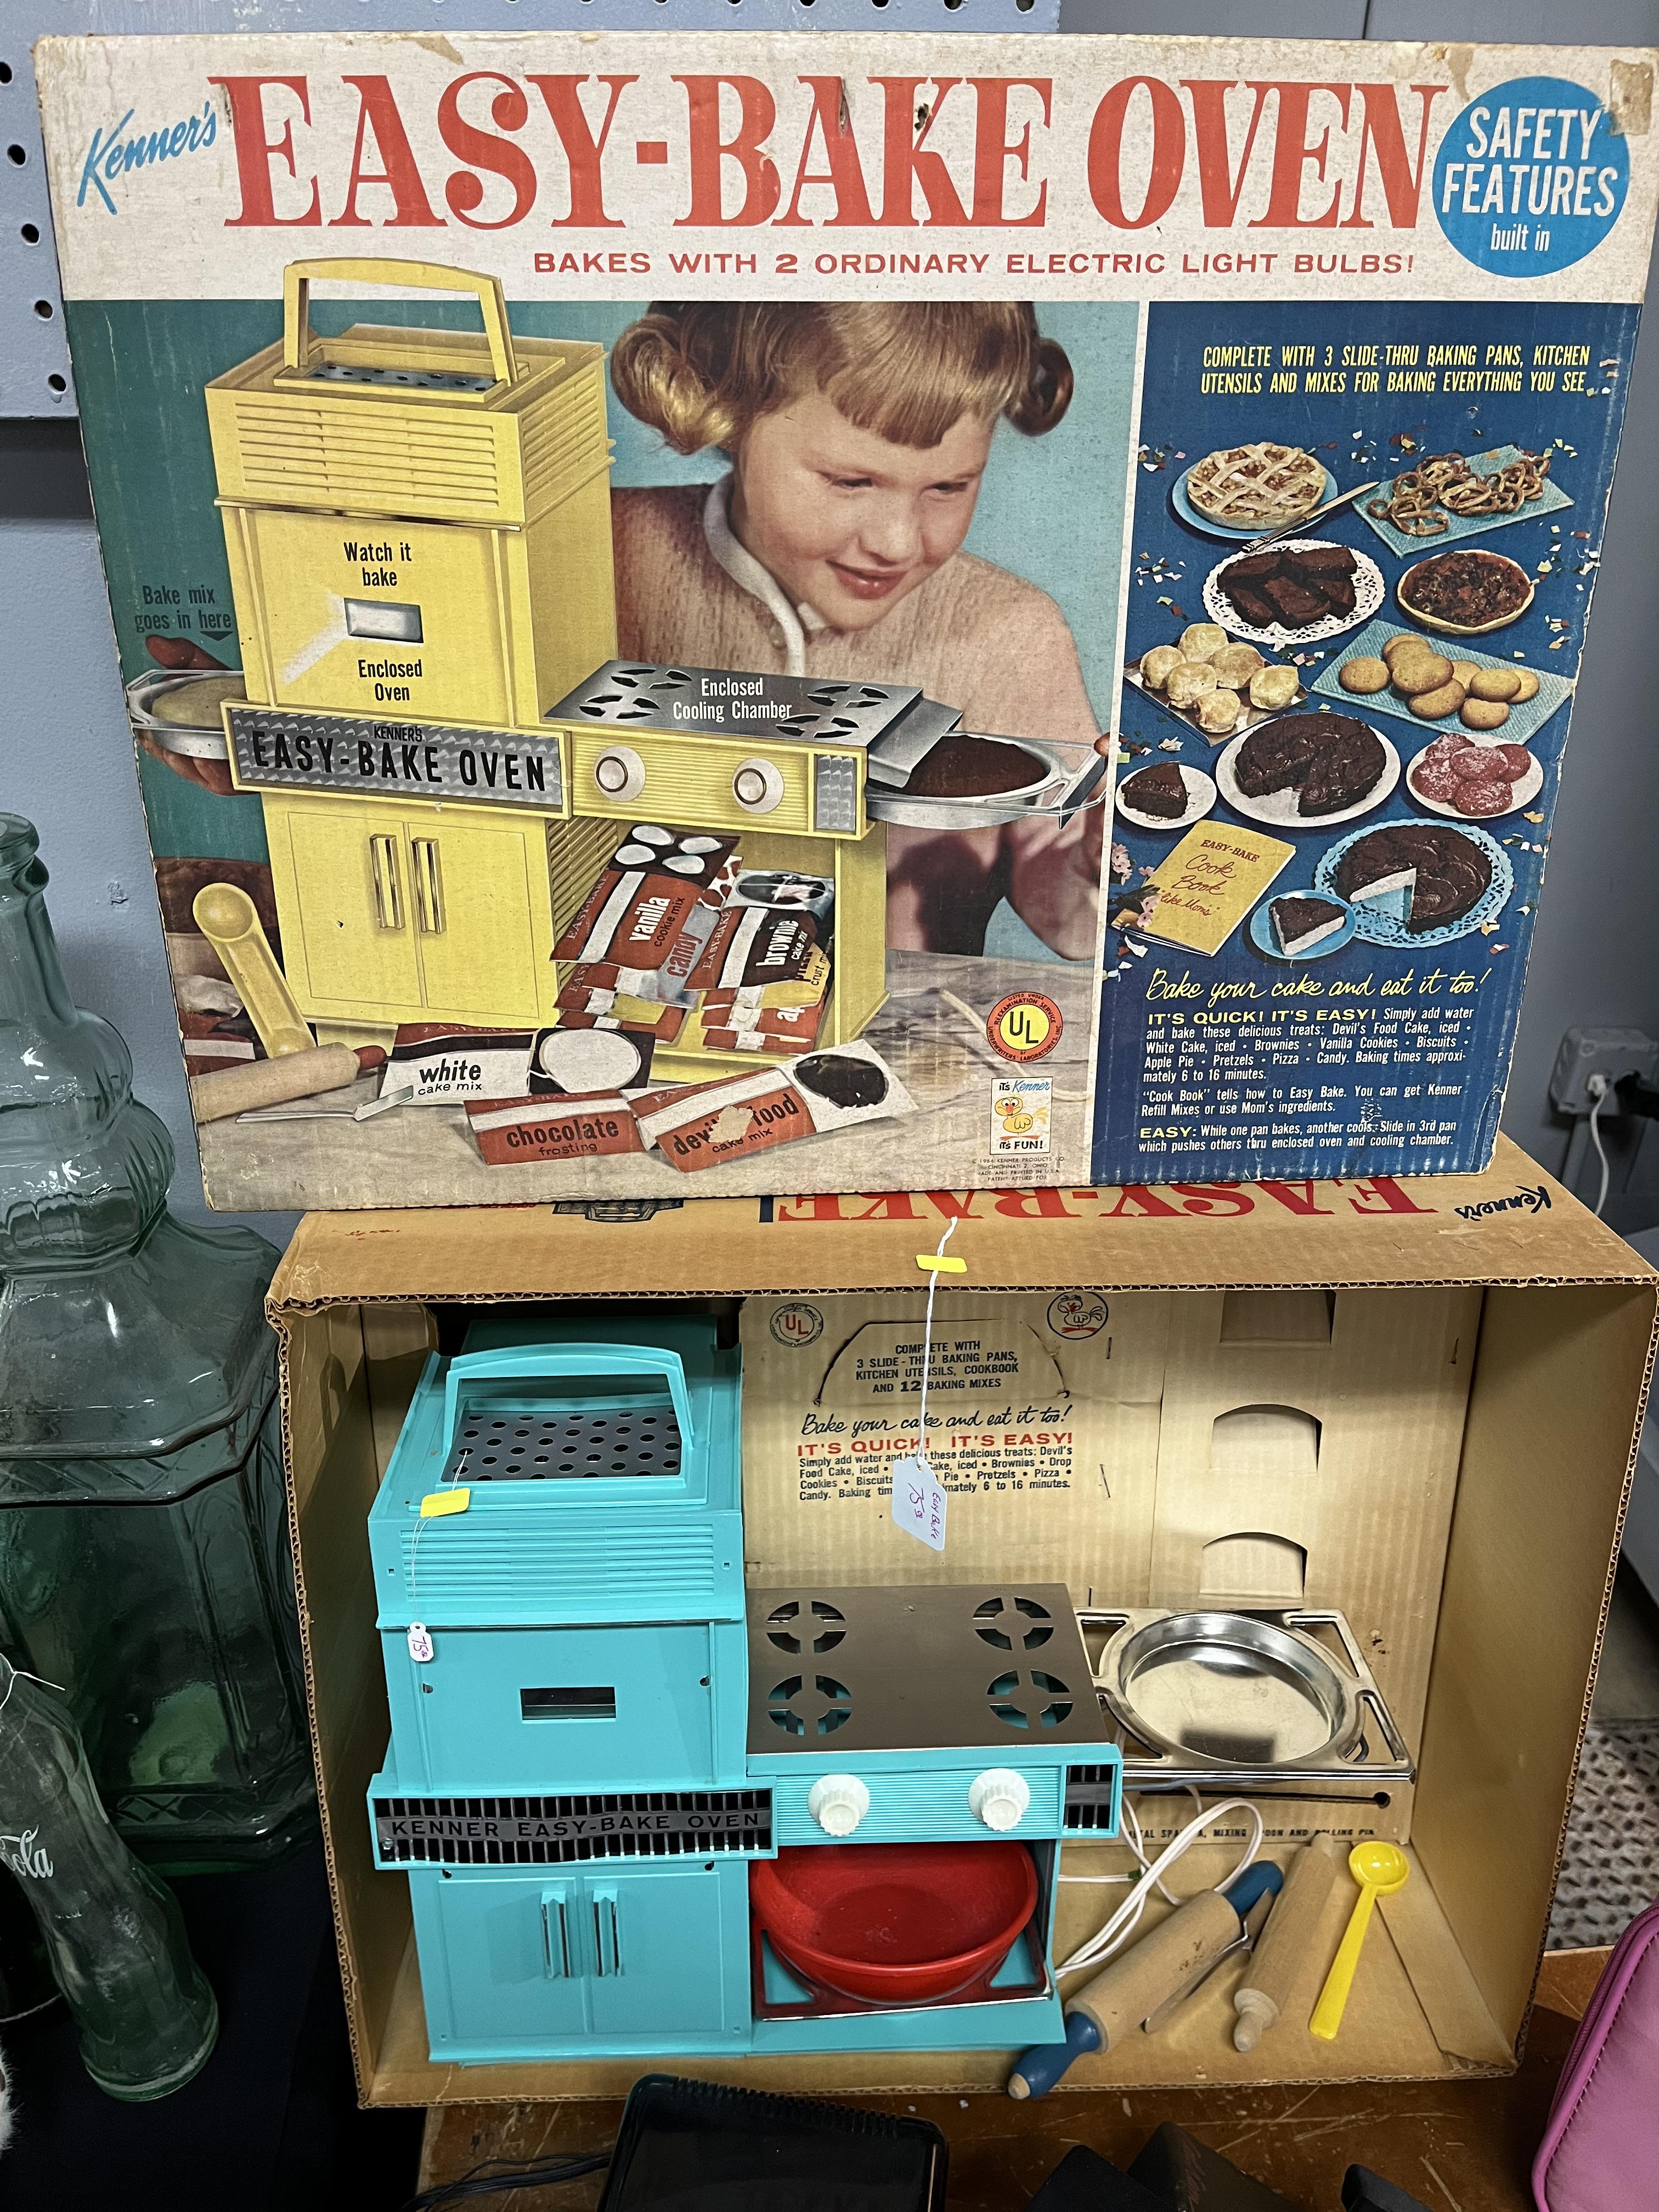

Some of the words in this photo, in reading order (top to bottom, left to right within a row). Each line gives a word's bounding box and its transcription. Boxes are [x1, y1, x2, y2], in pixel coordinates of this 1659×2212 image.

[1466, 106, 1604, 160] SAFETY
[77, 101, 216, 215] Kenner's
[207, 71, 1052, 229] EASY-BAKE
[1087, 75, 1449, 229] OVEN
[1441, 163, 1618, 217] FEATURES
[1491, 224, 1528, 251] built
[1534, 224, 1549, 251] in
[534, 253, 651, 273] BAKES
[669, 254, 757, 273] WITH
[775, 254, 798, 273] 2
[815, 254, 989, 274] ORDINARY
[1007, 253, 1165, 274] ELECTRIC
[1183, 253, 1278, 273] LIGHT
[1294, 254, 1414, 273] BULBS!
[1203, 345, 1272, 367] COMPLETE
[1282, 345, 1314, 367] WITH
[1324, 346, 1332, 367] 3
[1341, 345, 1418, 368] SLIDE-THRU
[1427, 345, 1476, 367] BAKING
[1486, 345, 1523, 369] PANS,
[1533, 345, 1590, 366] KITCHEN
[1201, 373, 1262, 394] UTENSILS
[1269, 372, 1297, 393] AND
[1305, 372, 1345, 393] MIXES
[1355, 371, 1379, 393] FOR
[1387, 371, 1435, 393] BAKING
[1443, 370, 1521, 393] EVERYTHING
[1530, 371, 1556, 392] YOU
[344, 541, 394, 563] Watch
[400, 542, 412, 562] it
[362, 567, 398, 587] bake
[143, 585, 181, 605] Bake
[189, 586, 216, 605] mix
[134, 612, 170, 633] goes
[177, 610, 191, 630] in
[199, 608, 232, 629] here
[358, 658, 423, 679] Enclosed
[374, 682, 410, 702] Oven
[701, 678, 763, 696] Enclosed
[673, 701, 724, 723] Cooling
[732, 701, 792, 719] Chamber
[374, 725, 422, 742] KENNER'S
[252, 731, 444, 783] EASY-BAKE
[459, 749, 546, 791] OVEN
[1200, 839, 1260, 862] EASY-BAKE
[1186, 854, 1237, 878] Cook
[1171, 875, 1227, 895] Book
[629, 896, 671, 941] vanilla
[654, 916, 675, 946] cookie
[672, 897, 685, 915] mix
[703, 911, 732, 968] EASY-BAKE
[755, 920, 799, 966] brownie
[791, 943, 804, 960] cake
[811, 966, 825, 985] crust
[1146, 967, 1204, 1001] Bake
[1207, 979, 1268, 1008] your
[1270, 974, 1325, 997] cake
[1328, 973, 1376, 997] and
[1380, 969, 1415, 996] eat
[1419, 968, 1449, 995] it
[1448, 967, 1492, 995] too!
[1148, 1013, 1184, 1025] IT'S
[1193, 1011, 1265, 1024] QUICK!
[1271, 1010, 1307, 1022] IT'S
[1316, 1008, 1376, 1021] EASY!
[1383, 1008, 1416, 1021] Simply
[1421, 1007, 1440, 1020] add
[1445, 1008, 1474, 1019] water
[1009, 1011, 1039, 1043] UL
[1146, 1028, 1165, 1040] and
[1172, 1027, 1195, 1039] bake
[1203, 1026, 1230, 1039] these
[1238, 1025, 1282, 1037] delicious
[1290, 1024, 1325, 1036] treats:
[1332, 1022, 1366, 1035] Devil's
[1373, 1023, 1397, 1034] Food
[1404, 1022, 1430, 1035] Cake,
[1439, 1022, 1460, 1034] iced
[1146, 1041, 1175, 1054] White
[1181, 1041, 1208, 1054] Cake,
[1215, 1040, 1235, 1052] iced
[1255, 1039, 1299, 1051] Brownies
[1320, 1037, 1352, 1049] Vanilla
[1360, 1037, 1398, 1049] Cookies
[1417, 1036, 1456, 1048] Biscuits
[1144, 1056, 1171, 1070] Apple
[1178, 1056, 1194, 1068] Pie
[1213, 1054, 1254, 1066] Pretzels
[1272, 1053, 1299, 1065] Pizza
[1317, 1052, 1349, 1066] Candy.
[1355, 1051, 1388, 1065] Baking
[1393, 1051, 1421, 1063] times
[1426, 1050, 1466, 1064] approxi-
[419, 1058, 481, 1084] white
[1143, 1070, 1176, 1085] mately
[1182, 1070, 1188, 1082] 6
[1193, 1069, 1204, 1081] to
[1209, 1069, 1220, 1081] 16
[1224, 1068, 1267, 1081] minutes.
[418, 1083, 451, 1095] cake
[456, 1081, 482, 1090] mix
[1012, 1080, 1050, 1092] Kenner
[506, 1119, 619, 1148] chocolate
[748, 1128, 773, 1142] mix
[1140, 1126, 1197, 1138] EASY:
[1201, 1125, 1227, 1136] While
[1231, 1125, 1248, 1136] one
[1251, 1125, 1268, 1137] pan
[1272, 1123, 1302, 1135] bakes,
[538, 1143, 597, 1156] frosting
[1014, 1141, 1043, 1149] FUN!
[1454, 1185, 1551, 1221] Kenner's
[786, 1314, 809, 1335] UL
[955, 1341, 980, 1351] WITH
[942, 1353, 979, 1364] BAKING
[987, 1351, 1018, 1362] PANS,
[856, 1369, 899, 1380] KITCHEN
[964, 1363, 1019, 1374] COOKBOOK
[900, 1381, 922, 1392] 12
[969, 1378, 1001, 1388] MIXES
[802, 1413, 848, 1435] Bake
[851, 1419, 898, 1438] your
[946, 1410, 983, 1427] and
[1040, 1404, 1073, 1423] too!
[798, 1442, 842, 1457] IT'S
[951, 1435, 995, 1447] IT'S
[1004, 1432, 1073, 1446] EASY!
[960, 1448, 1001, 1458] delicious
[992, 1458, 1035, 1468] Brownies
[799, 1489, 831, 1500] Candy.
[1029, 1480, 1070, 1489] minutes.
[392, 1820, 500, 1837] KENNER
[518, 1815, 670, 1838] EASY-BAKE
[687, 1813, 759, 1829] OVEN
